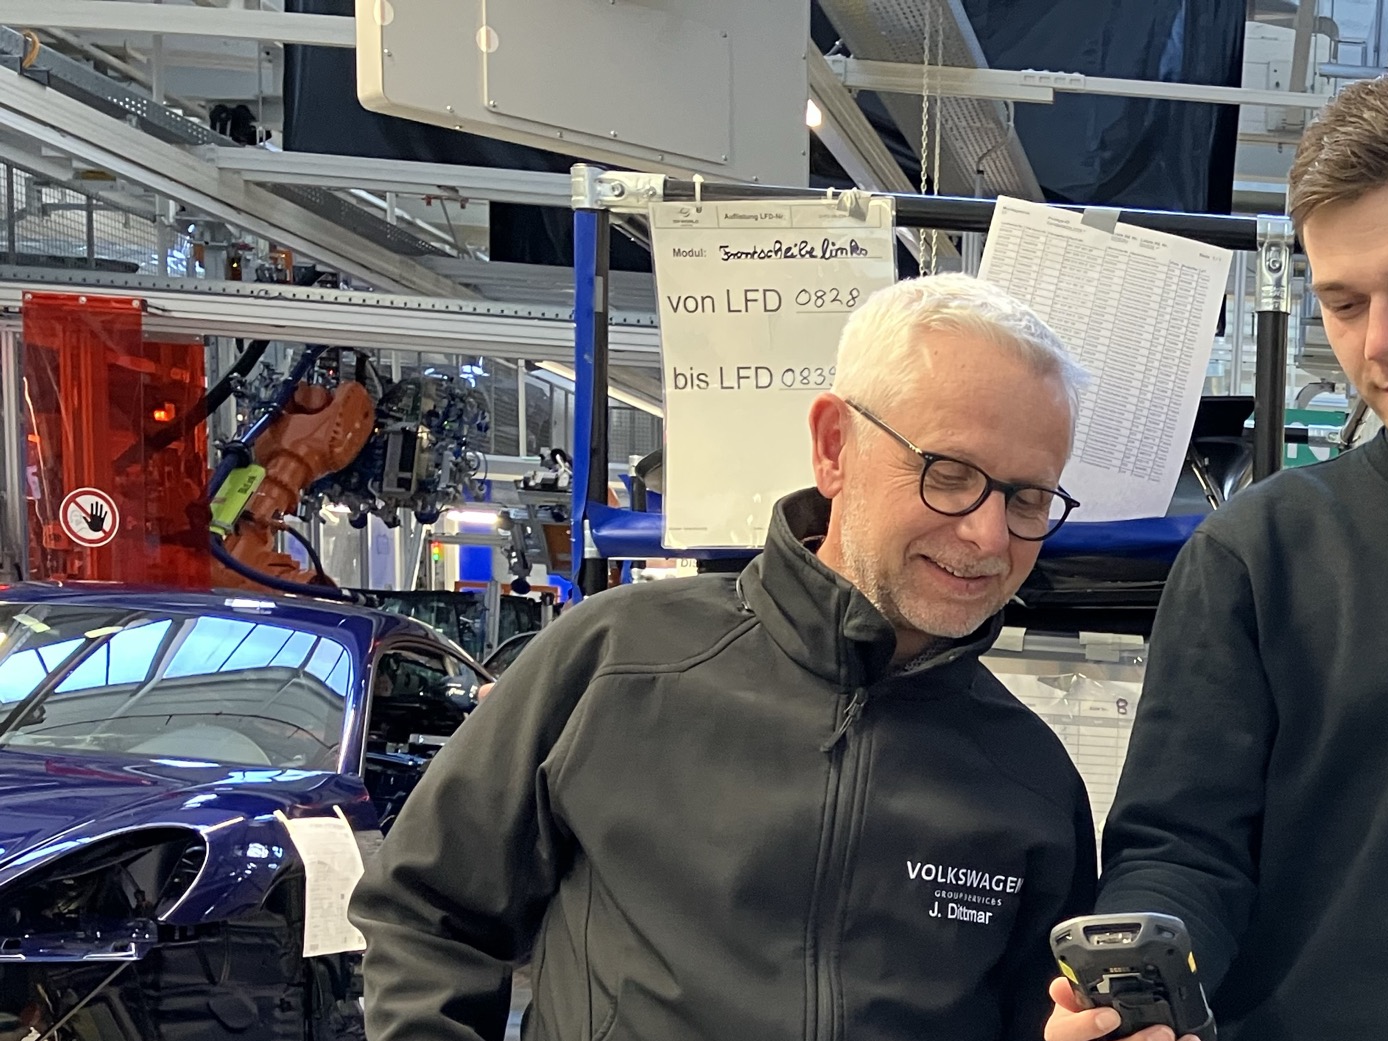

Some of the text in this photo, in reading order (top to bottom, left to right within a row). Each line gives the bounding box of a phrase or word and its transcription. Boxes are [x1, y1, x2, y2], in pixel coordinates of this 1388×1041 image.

[672, 248, 707, 258] Modul:
[667, 287, 861, 313] von LFD 0828
[673, 366, 709, 390] bis
[719, 366, 773, 390] LFD
[928, 901, 993, 925] J. Dittmar
